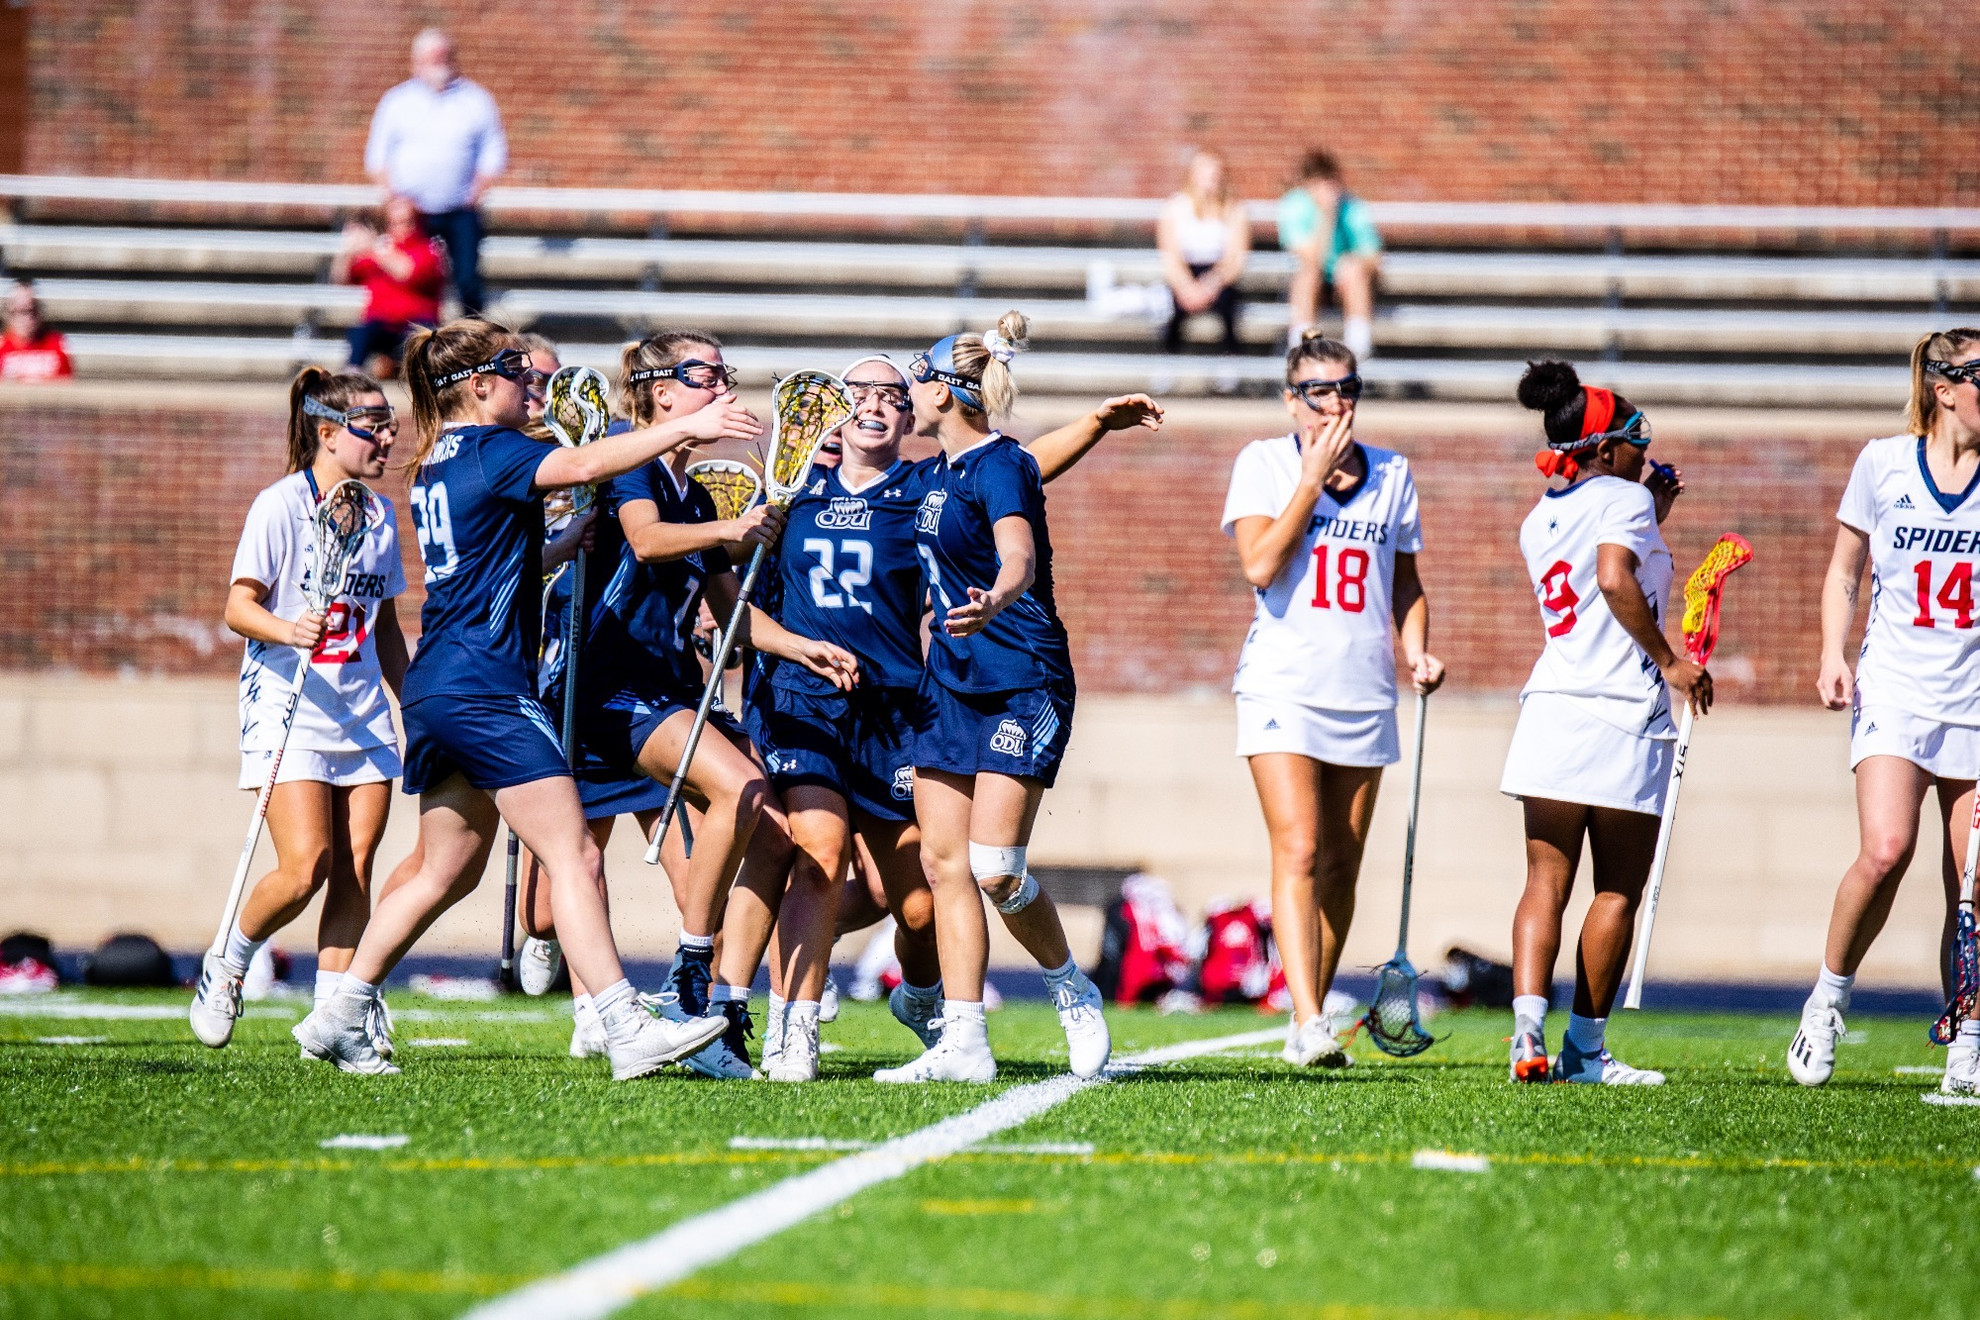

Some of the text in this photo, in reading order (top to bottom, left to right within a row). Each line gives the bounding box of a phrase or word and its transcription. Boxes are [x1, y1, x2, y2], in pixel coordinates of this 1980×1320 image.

[451, 362, 498, 381] GAIT GAI
[653, 369, 674, 377] GAIT
[937, 373, 963, 386] GAIT
[816, 509, 873, 530] ODU
[1306, 514, 1388, 545] PIDERS
[803, 537, 873, 616] 22
[1311, 544, 1371, 614] 18
[1540, 559, 1580, 639] 9
[1913, 560, 1975, 629] 14
[310, 602, 362, 665] 21
[990, 733, 1025, 755] ODU
